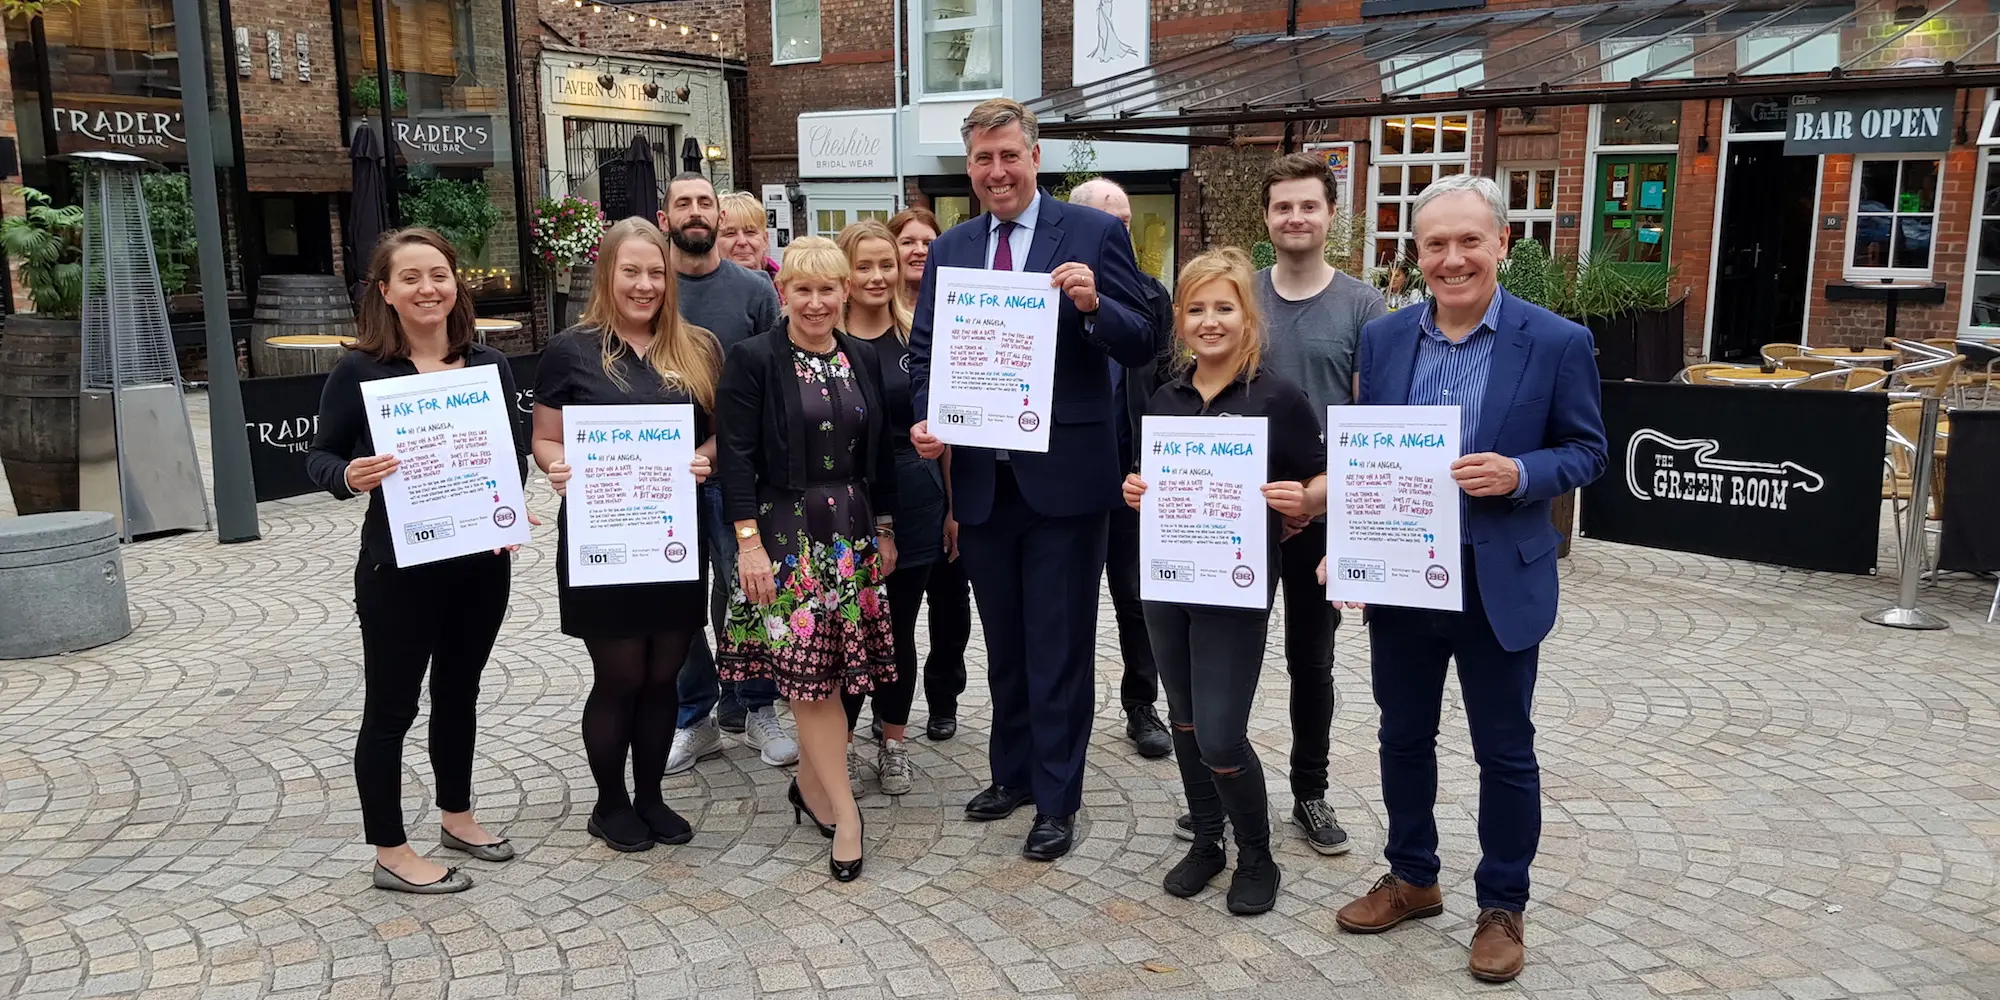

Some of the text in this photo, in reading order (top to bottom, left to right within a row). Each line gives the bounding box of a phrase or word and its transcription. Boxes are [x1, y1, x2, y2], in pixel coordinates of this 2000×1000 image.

[555, 76, 689, 104] TAVERN ON TH GRE
[53, 108, 186, 142] TRADER'
[1793, 107, 1942, 140] BAR OPEN
[108, 134, 169, 148] TIKI BAR
[392, 122, 488, 150] RADER'S
[809, 125, 881, 157] Cheshire
[422, 143, 464, 155] TIKI BAR
[849, 160, 874, 168] WEAR
[947, 291, 1046, 310] #ASK FOR ANGELA
[381, 402, 414, 419] #ASK
[418, 397, 442, 414] FOR
[445, 391, 490, 408] ANGELA
[947, 414, 964, 423] 101
[577, 428, 680, 443] #ASK FOR ANGELA
[1339, 433, 1444, 449] #ASK FOR ANGELA
[287, 441, 309, 453] TIKI
[1153, 441, 1253, 457] #ASK FOR ANGELA
[1654, 454, 1674, 467] THE
[1653, 469, 1788, 510] GREEN ROOM
[416, 530, 435, 541] 101
[589, 554, 607, 563] 101
[1159, 570, 1176, 579] 101
[1348, 569, 1365, 579] 101
